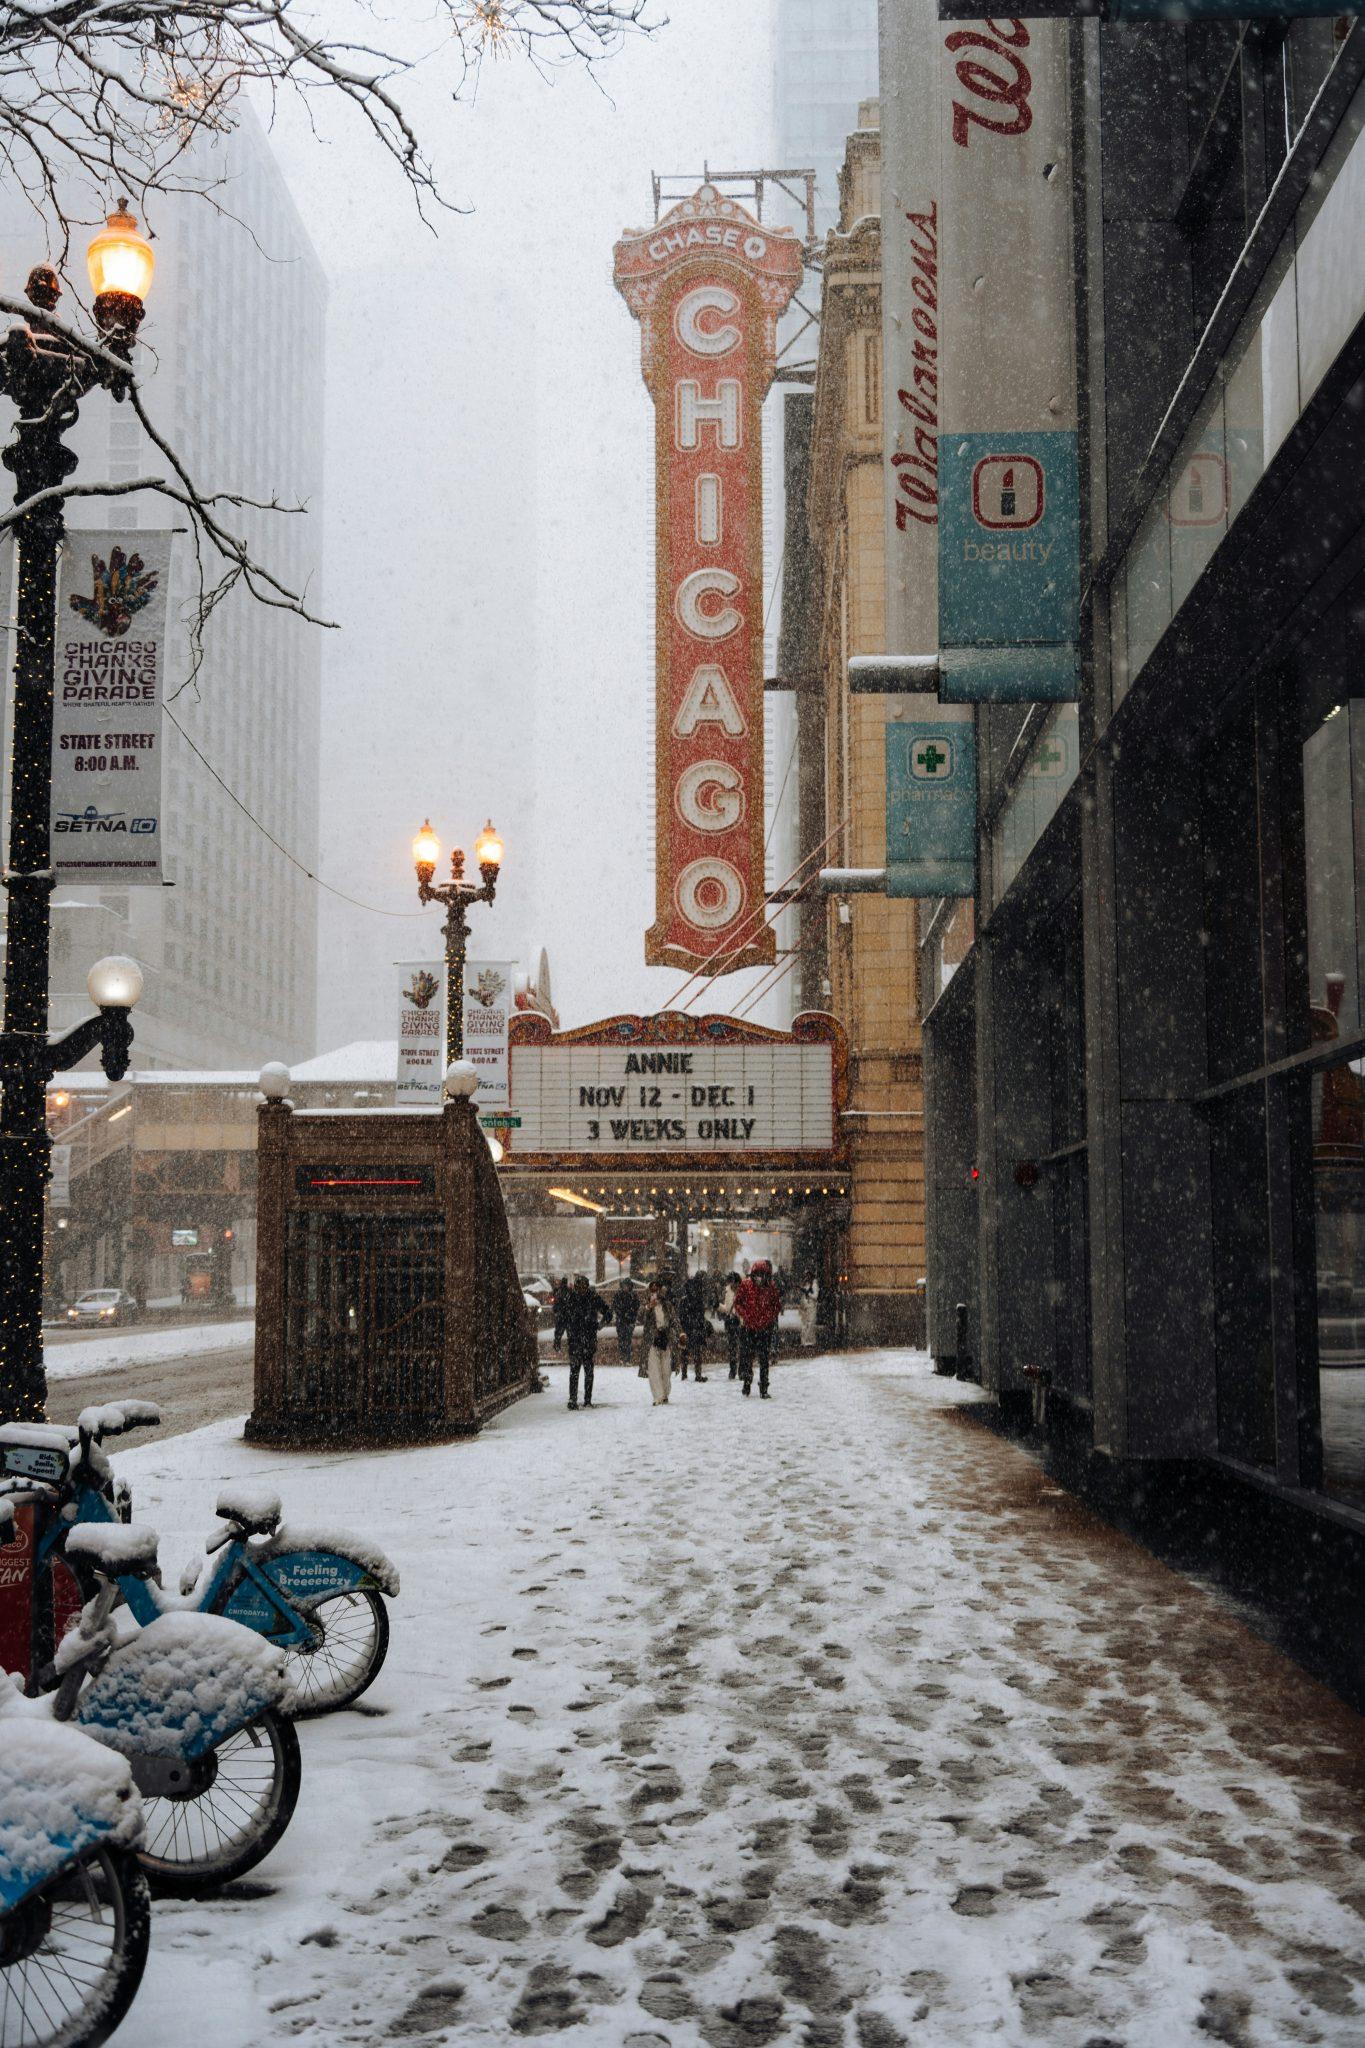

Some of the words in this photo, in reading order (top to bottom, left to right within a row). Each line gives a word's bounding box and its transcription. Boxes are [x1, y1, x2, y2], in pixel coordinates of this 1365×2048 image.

[648, 225, 740, 261] CHASE
[963, 539, 1055, 566] beauty
[673, 286, 747, 933] CHICAGO
[65, 641, 157, 655] CHICAGO
[64, 654, 156, 669] THANKS
[63, 669, 156, 686] GIVING
[63, 686, 155, 700] PARADE
[60, 734, 101, 749] STATE
[104, 734, 155, 749] STREET
[74, 756, 106, 771] 8:00
[109, 755, 139, 770] A.M.
[890, 787, 973, 805] pharmacy
[54, 820, 127, 833] SETNA
[467, 1020, 505, 1028] GIVING
[625, 1052, 693, 1075] ANNIE
[579, 1085, 626, 1108] NOV
[640, 1085, 662, 1108] 12
[691, 1085, 735, 1108] DEC
[587, 1119, 600, 1141] 3
[609, 1118, 687, 1141] WEEKS
[697, 1118, 757, 1141] ONLY
[293, 1564, 338, 1577] Feeling
[279, 1573, 351, 1587] Breeeeeezy
